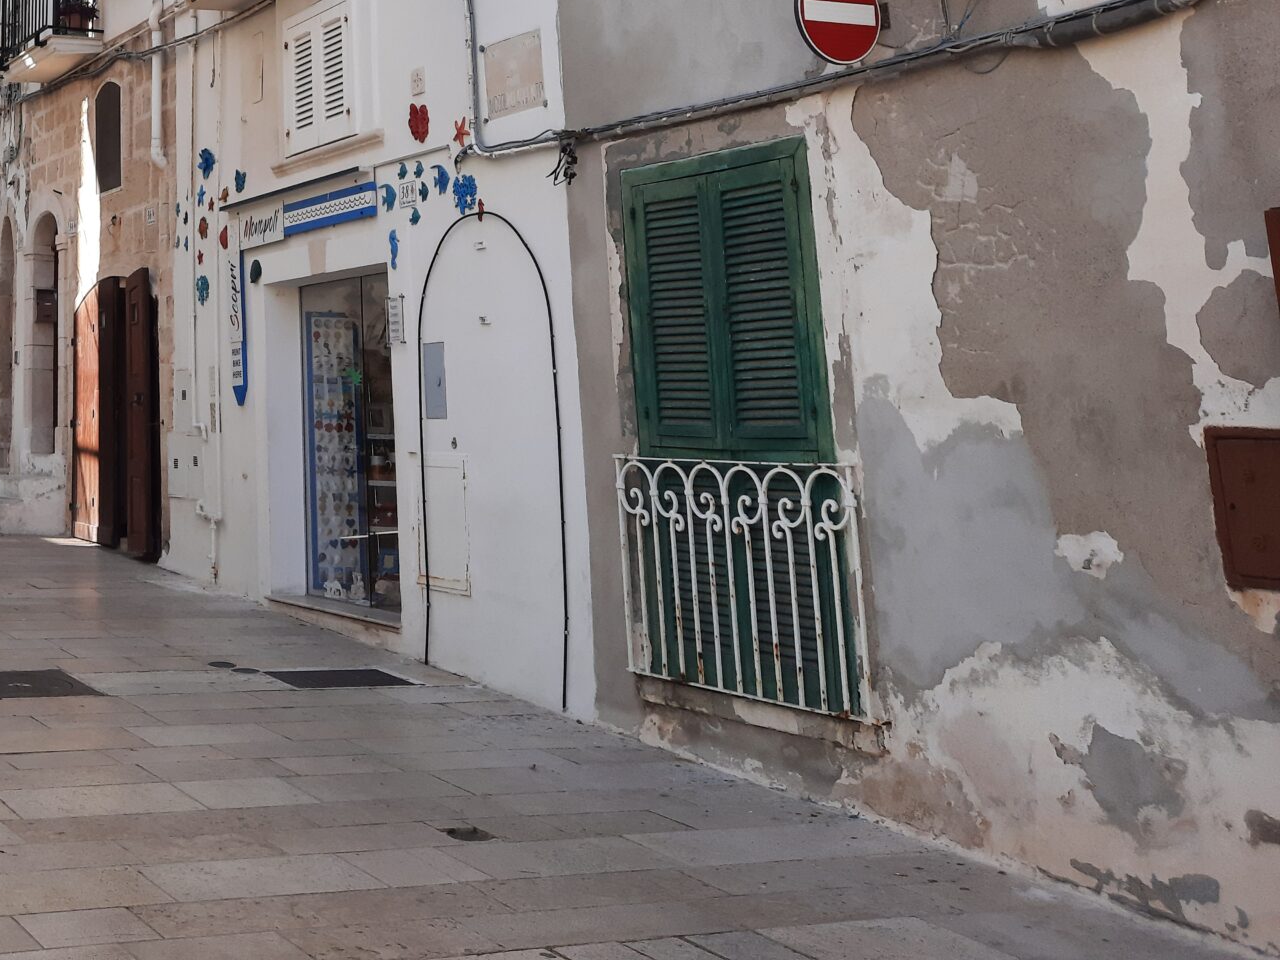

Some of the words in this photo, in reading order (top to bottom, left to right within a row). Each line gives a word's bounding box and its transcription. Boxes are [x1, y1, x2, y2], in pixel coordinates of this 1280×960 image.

[401, 184, 410, 199] 38
[243, 209, 280, 242] Monopoli
[228, 260, 242, 332] Scopri
